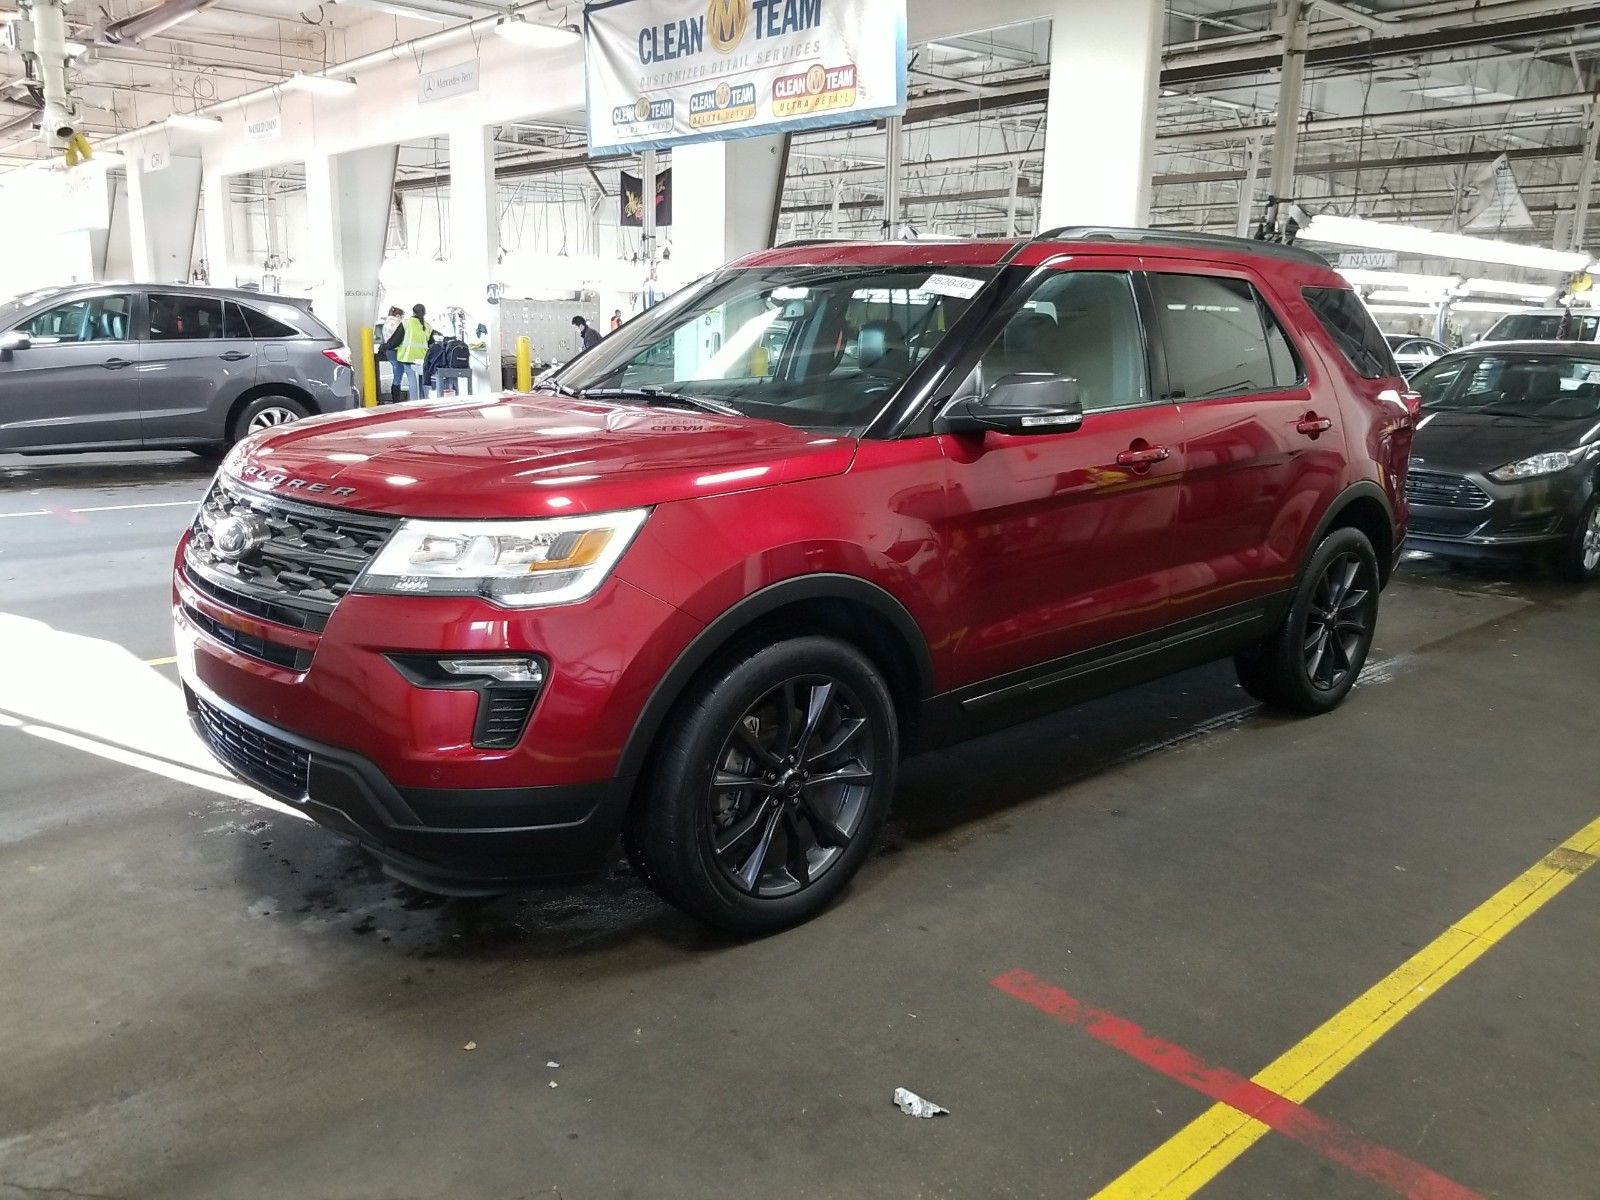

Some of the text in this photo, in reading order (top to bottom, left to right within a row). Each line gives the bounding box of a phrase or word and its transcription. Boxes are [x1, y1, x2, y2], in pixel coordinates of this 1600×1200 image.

[638, 15, 704, 65] CLEAN
[753, 0, 822, 40] TEAM
[639, 40, 820, 87] CUSTOMIZED DETAIL SERVICES
[775, 77, 806, 98] CLEAN
[826, 68, 853, 90] TEAM
[613, 105, 635, 124] CLEAN
[650, 101, 672, 119] TEAM
[690, 93, 715, 112] CLEAN
[731, 85, 754, 105] TEAM
[779, 92, 849, 111] ULTRA DETAIL
[233, 458, 358, 498] PLORER
